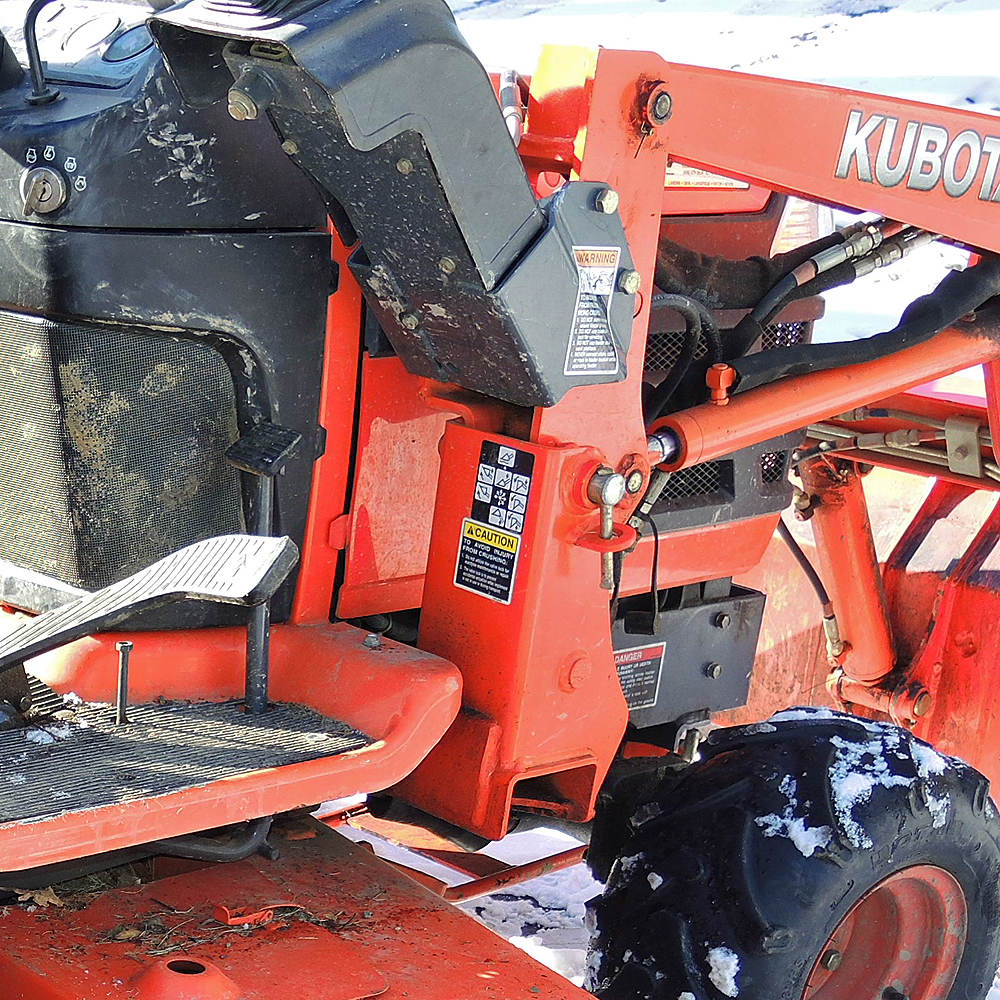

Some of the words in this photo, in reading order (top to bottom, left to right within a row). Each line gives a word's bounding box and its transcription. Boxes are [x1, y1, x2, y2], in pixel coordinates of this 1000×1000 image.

[834, 109, 1000, 202] KUBOT
[577, 252, 616, 264] WARNING
[475, 528, 514, 548] CAUTION
[463, 545, 478, 555] FROM
[474, 542, 490, 552] AVOID
[494, 548, 514, 560] INJURY
[615, 651, 643, 663] DANGER
